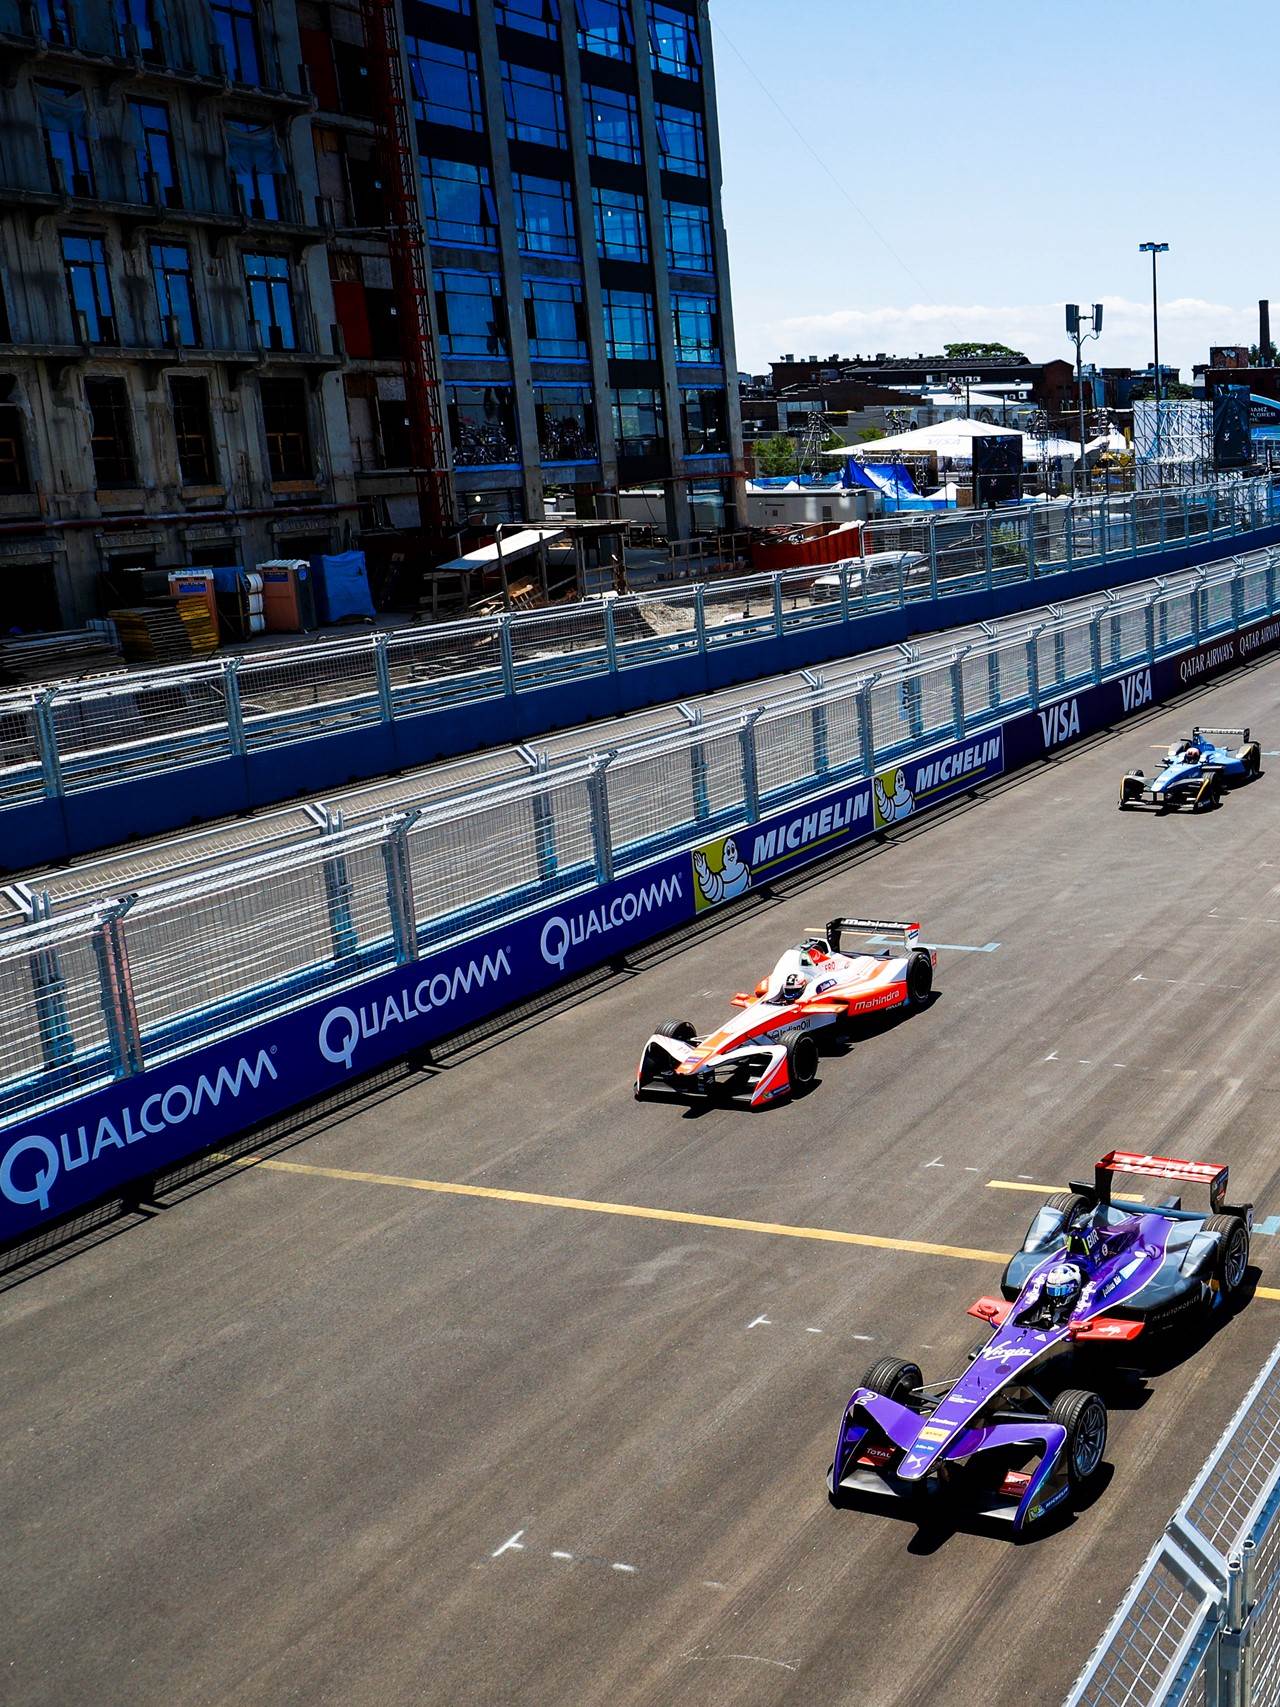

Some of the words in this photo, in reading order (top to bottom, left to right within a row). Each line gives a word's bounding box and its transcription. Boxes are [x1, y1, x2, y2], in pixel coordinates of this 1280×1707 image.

[1180, 654, 1205, 682] QATAR
[1205, 641, 1234, 668] AIRWAYS
[1239, 630, 1260, 656] QATAR
[1118, 669, 1152, 712] VISA
[1037, 698, 1080, 748] VISA
[915, 737, 1000, 793] MICHELIN
[752, 790, 870, 866] MICHELIN
[540, 873, 683, 970] QUALCOMM
[318, 948, 512, 1069] QUALCOMM
[0, 1046, 279, 1211] QUALCOMM
[983, 1341, 1034, 1364] Virgin
[854, 1392, 879, 1406] 2
[866, 1447, 892, 1459] TOTAL
